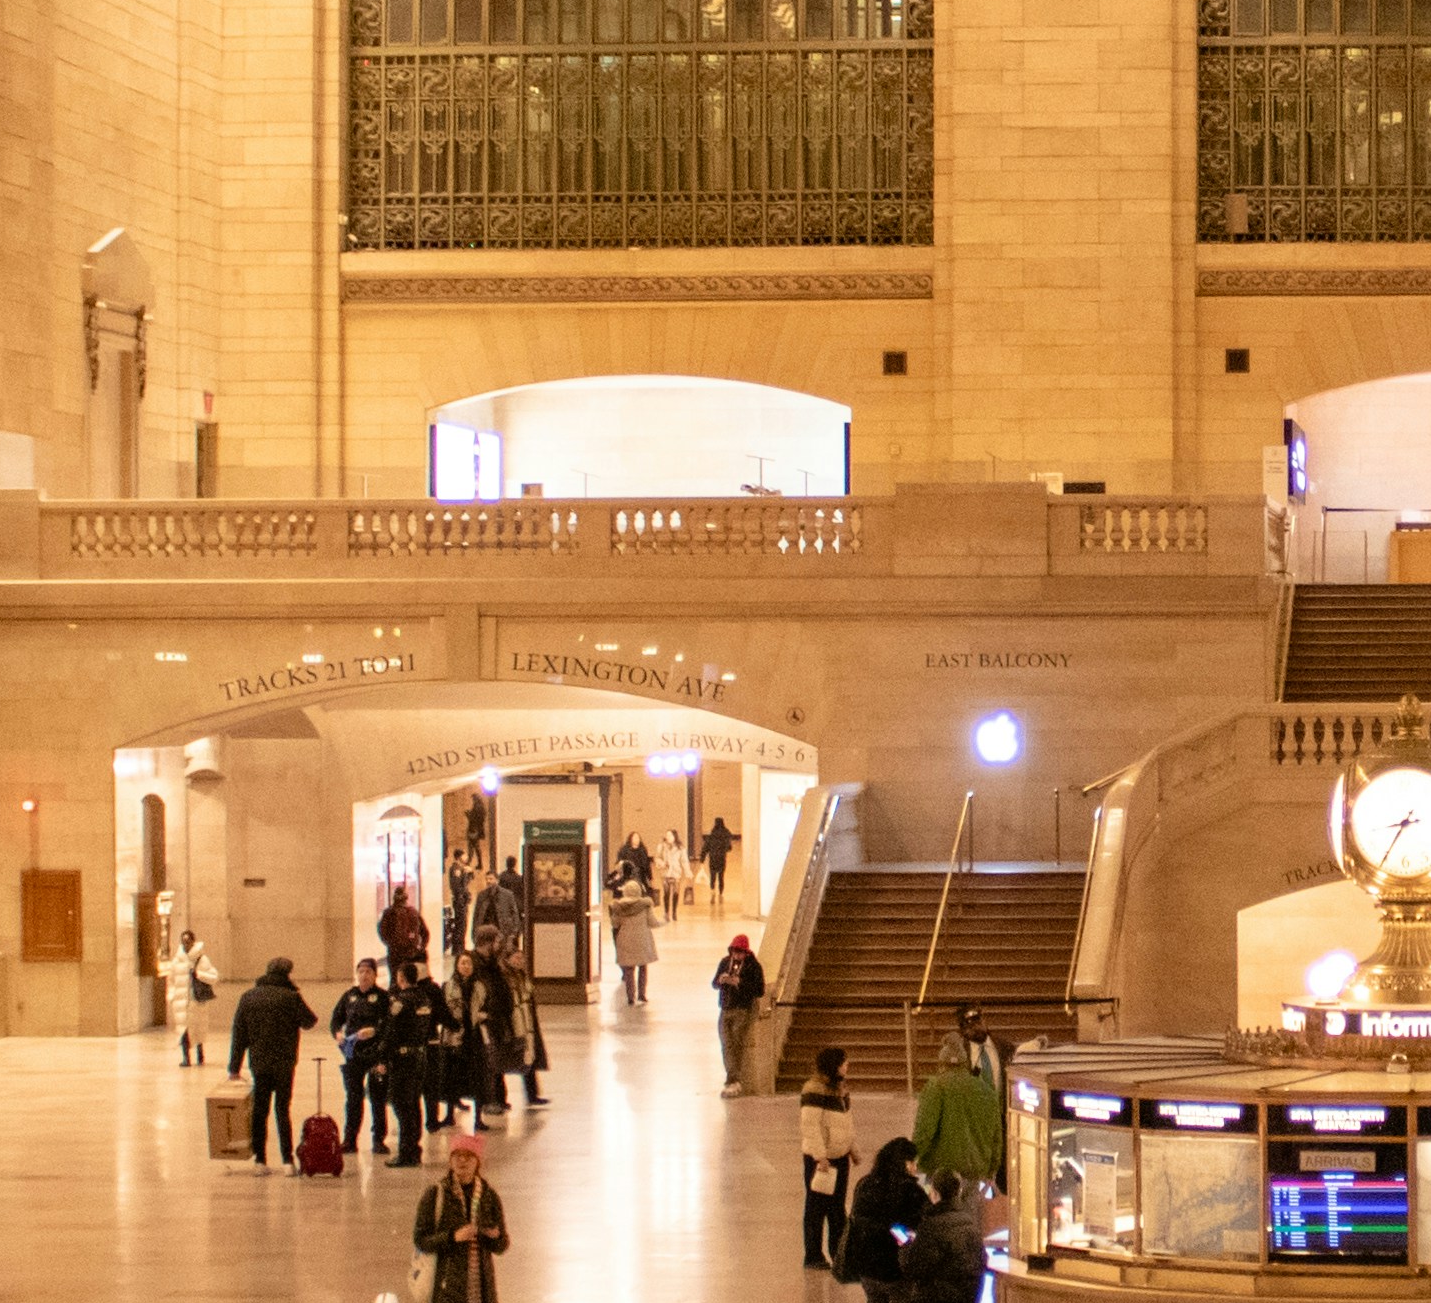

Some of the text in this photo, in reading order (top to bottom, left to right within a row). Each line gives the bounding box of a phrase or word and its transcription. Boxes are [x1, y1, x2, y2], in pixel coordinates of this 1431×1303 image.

[219, 653, 417, 701] TRACKS 21 TO 11
[512, 652, 726, 703] LEXINGTON AVE
[925, 652, 1073, 668] EAST BALCONY
[405, 731, 749, 776] 42ND STREET PASSAGE SUBWAY
[1304, 1156, 1371, 1168] ARRIVALS
